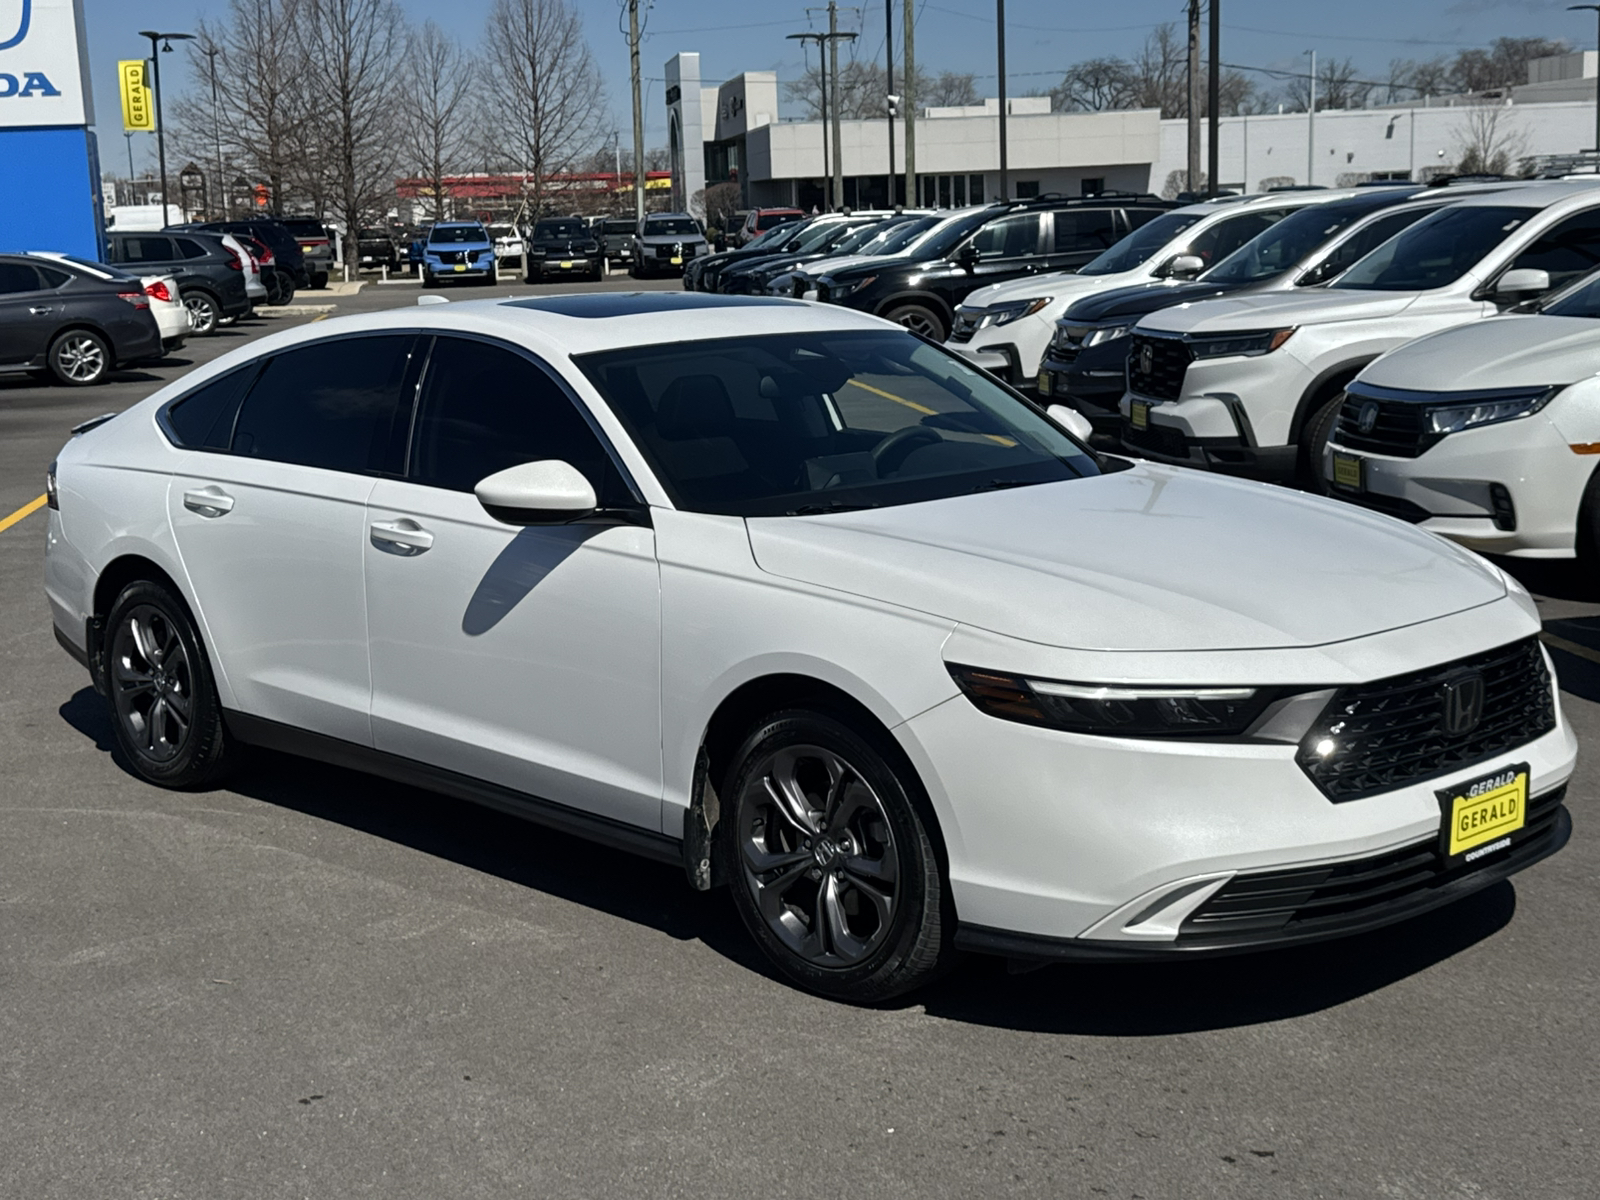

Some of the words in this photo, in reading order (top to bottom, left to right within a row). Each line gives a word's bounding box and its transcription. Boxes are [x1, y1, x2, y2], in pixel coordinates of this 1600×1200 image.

[130, 69, 143, 122] GERALD
[1469, 771, 1515, 797] GERALD
[1460, 798, 1516, 832] GERALD
